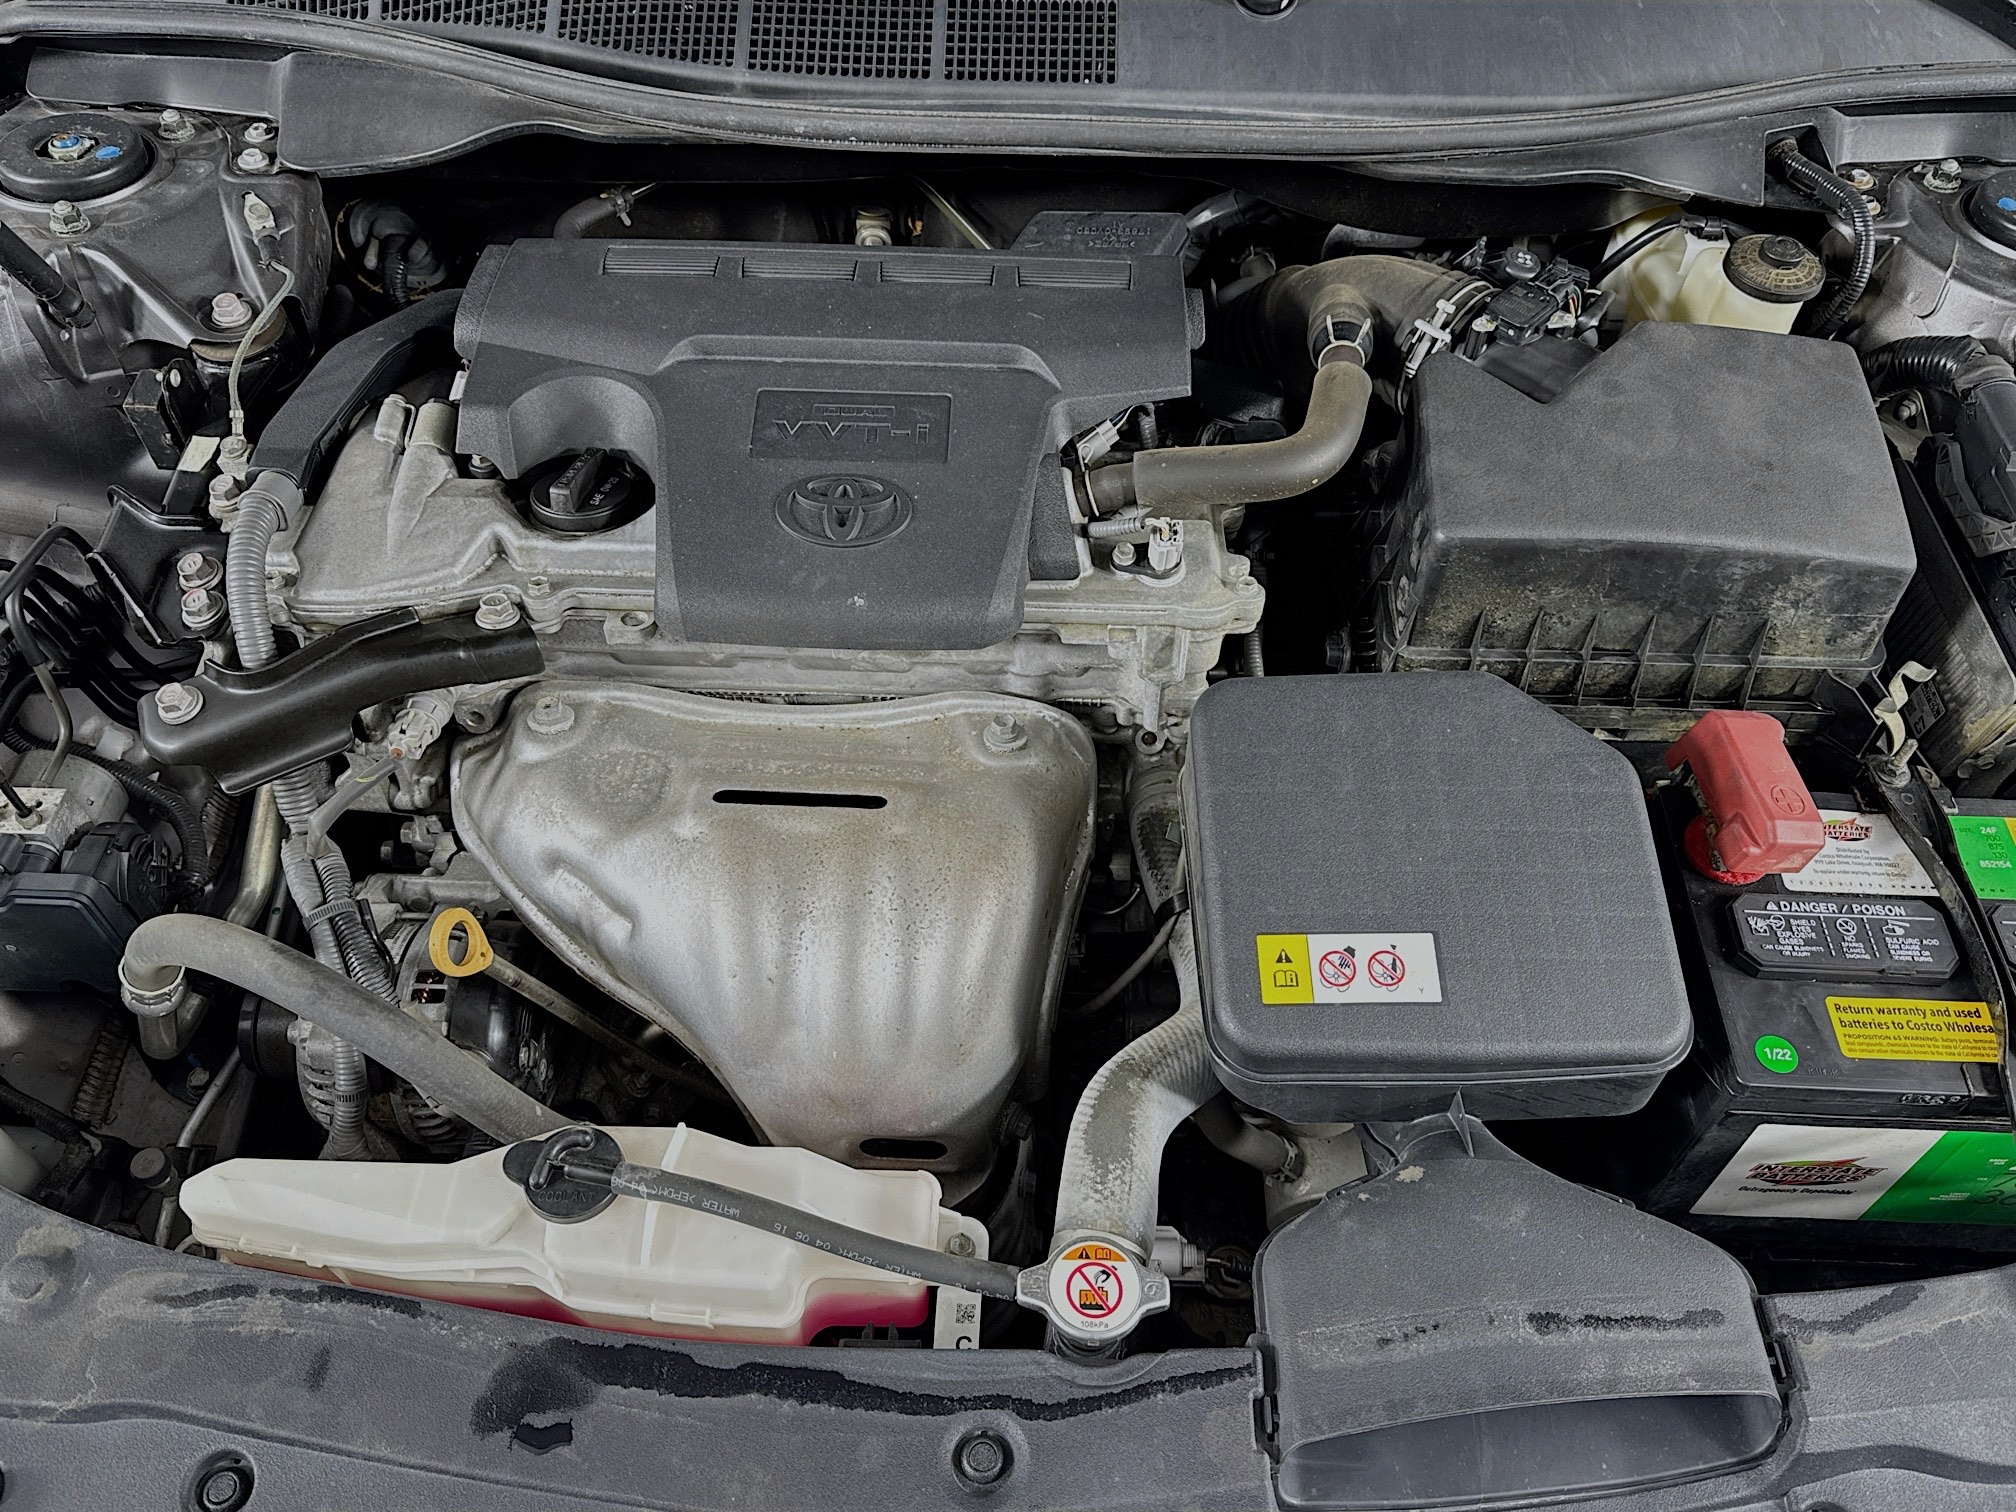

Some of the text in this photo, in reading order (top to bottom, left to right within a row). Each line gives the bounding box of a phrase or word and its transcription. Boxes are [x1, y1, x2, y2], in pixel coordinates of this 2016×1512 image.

[823, 406, 889, 417] DUAL
[772, 420, 930, 444] VVT-i
[589, 493, 605, 506] SAE
[1824, 825, 1872, 833] NTERSTATE
[1980, 826, 1997, 834] 24F
[1779, 901, 1838, 913] DANGER
[1852, 904, 1906, 916] POISON
[1776, 931, 1817, 939] EXPLOSIVE
[1885, 937, 1920, 945] SULFURIC
[1834, 1003, 1982, 1019] Return warranty and used
[1838, 1017, 1890, 1030] batteries
[1891, 1020, 1904, 1030] to
[1906, 1019, 1943, 1032] Costco
[1843, 1033, 1892, 1041] PROPOSITION
[1764, 1047, 1793, 1060] 1/22
[1750, 1163, 1881, 1176] INTERSTATE
[1746, 1172, 1866, 1183] BATTERIES
[1738, 1185, 1853, 1195] Outrageously Dependable
[537, 1191, 595, 1202] COOLANT
[702, 1198, 740, 1218] WATER
[774, 1222, 786, 1234] 16
[794, 1231, 810, 1243] 06
[815, 1238, 831, 1251] 04
[1080, 1320, 1109, 1329] 108kPa
